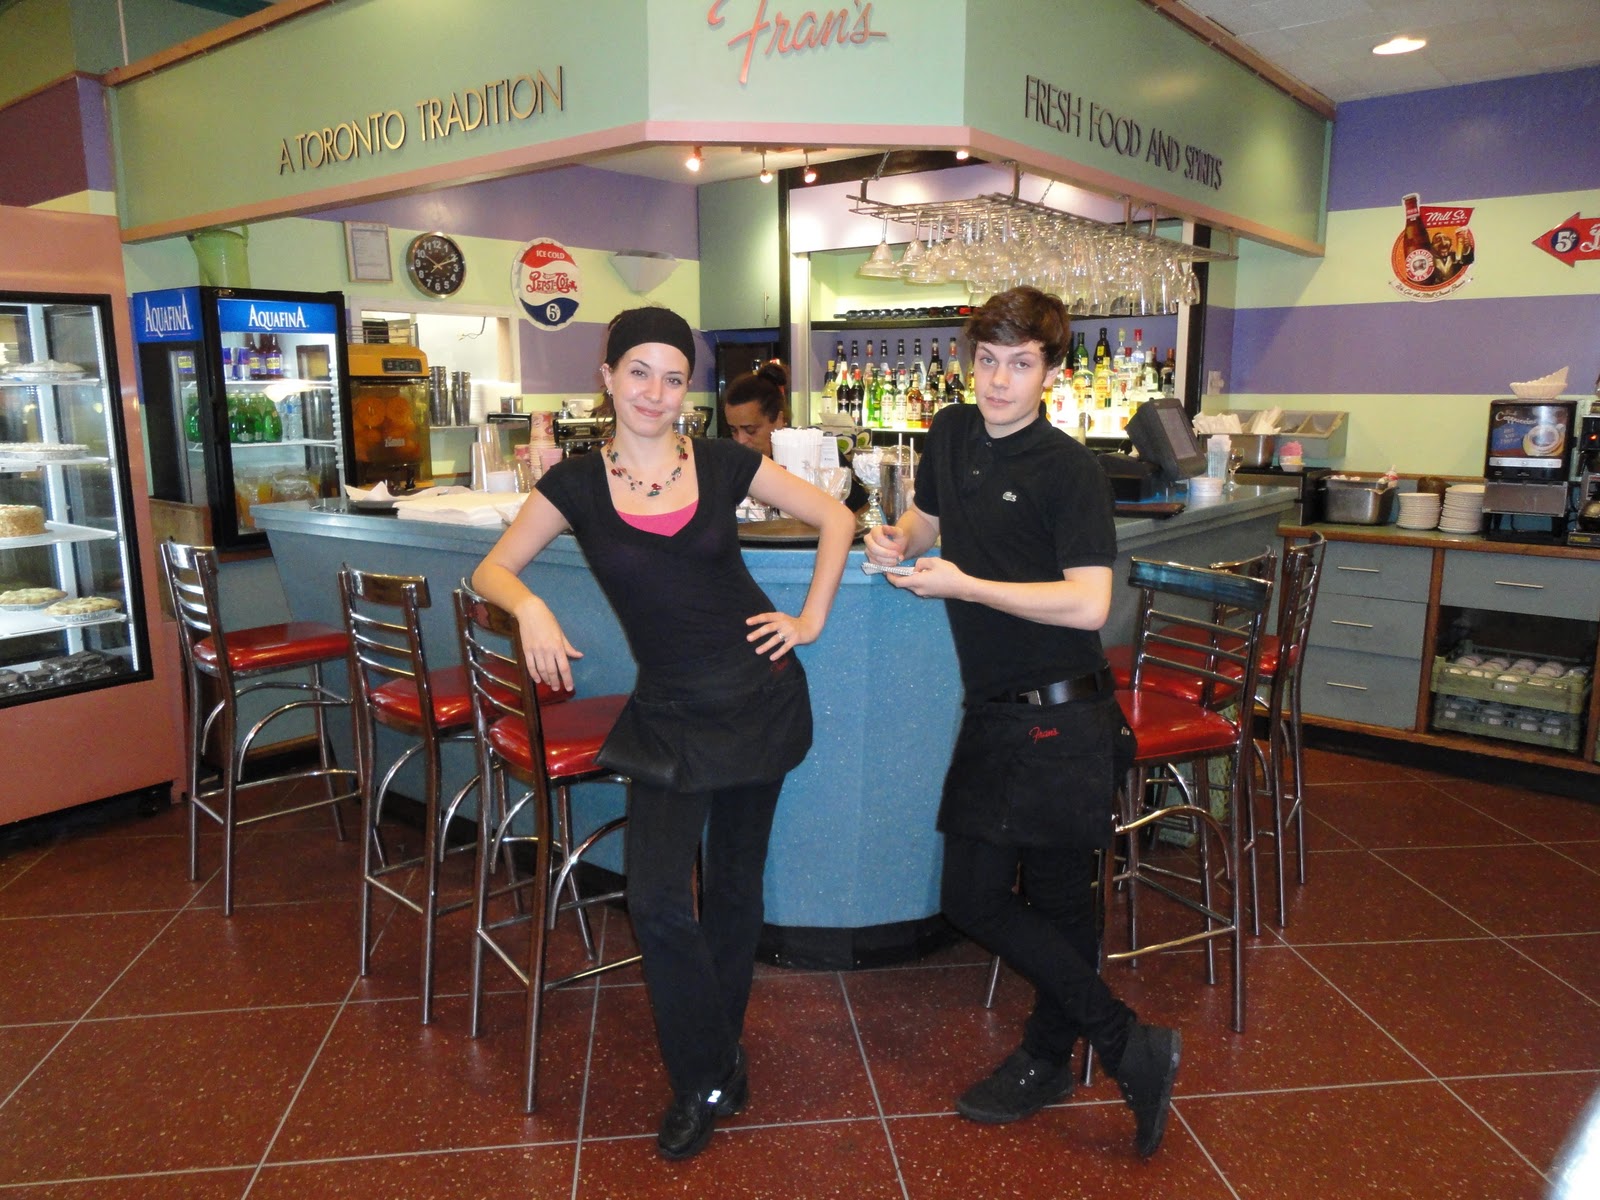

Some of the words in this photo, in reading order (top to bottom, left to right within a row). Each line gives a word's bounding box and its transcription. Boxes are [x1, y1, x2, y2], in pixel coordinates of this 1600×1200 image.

[279, 138, 295, 175] A
[295, 110, 406, 170] TORONTO
[416, 65, 563, 141] TRADITION
[1025, 75, 1081, 137] FRESH
[1089, 102, 1141, 157] FOOD
[1145, 128, 1180, 173] AND
[1184, 145, 1223, 190] SPIRITS
[1425, 210, 1452, 222] Mill
[423, 241, 431, 250] 11
[432, 240, 441, 249] 12
[444, 244, 449, 252] 1
[416, 249, 425, 258] 10
[536, 250, 546, 258] ICE
[547, 251, 565, 259] COLD
[415, 259, 421, 267] 9
[453, 264, 459, 272] 3
[419, 270, 424, 279] 8
[450, 274, 456, 282] 4
[426, 279, 432, 287] 7
[435, 282, 441, 291] 6
[444, 281, 450, 289] 5
